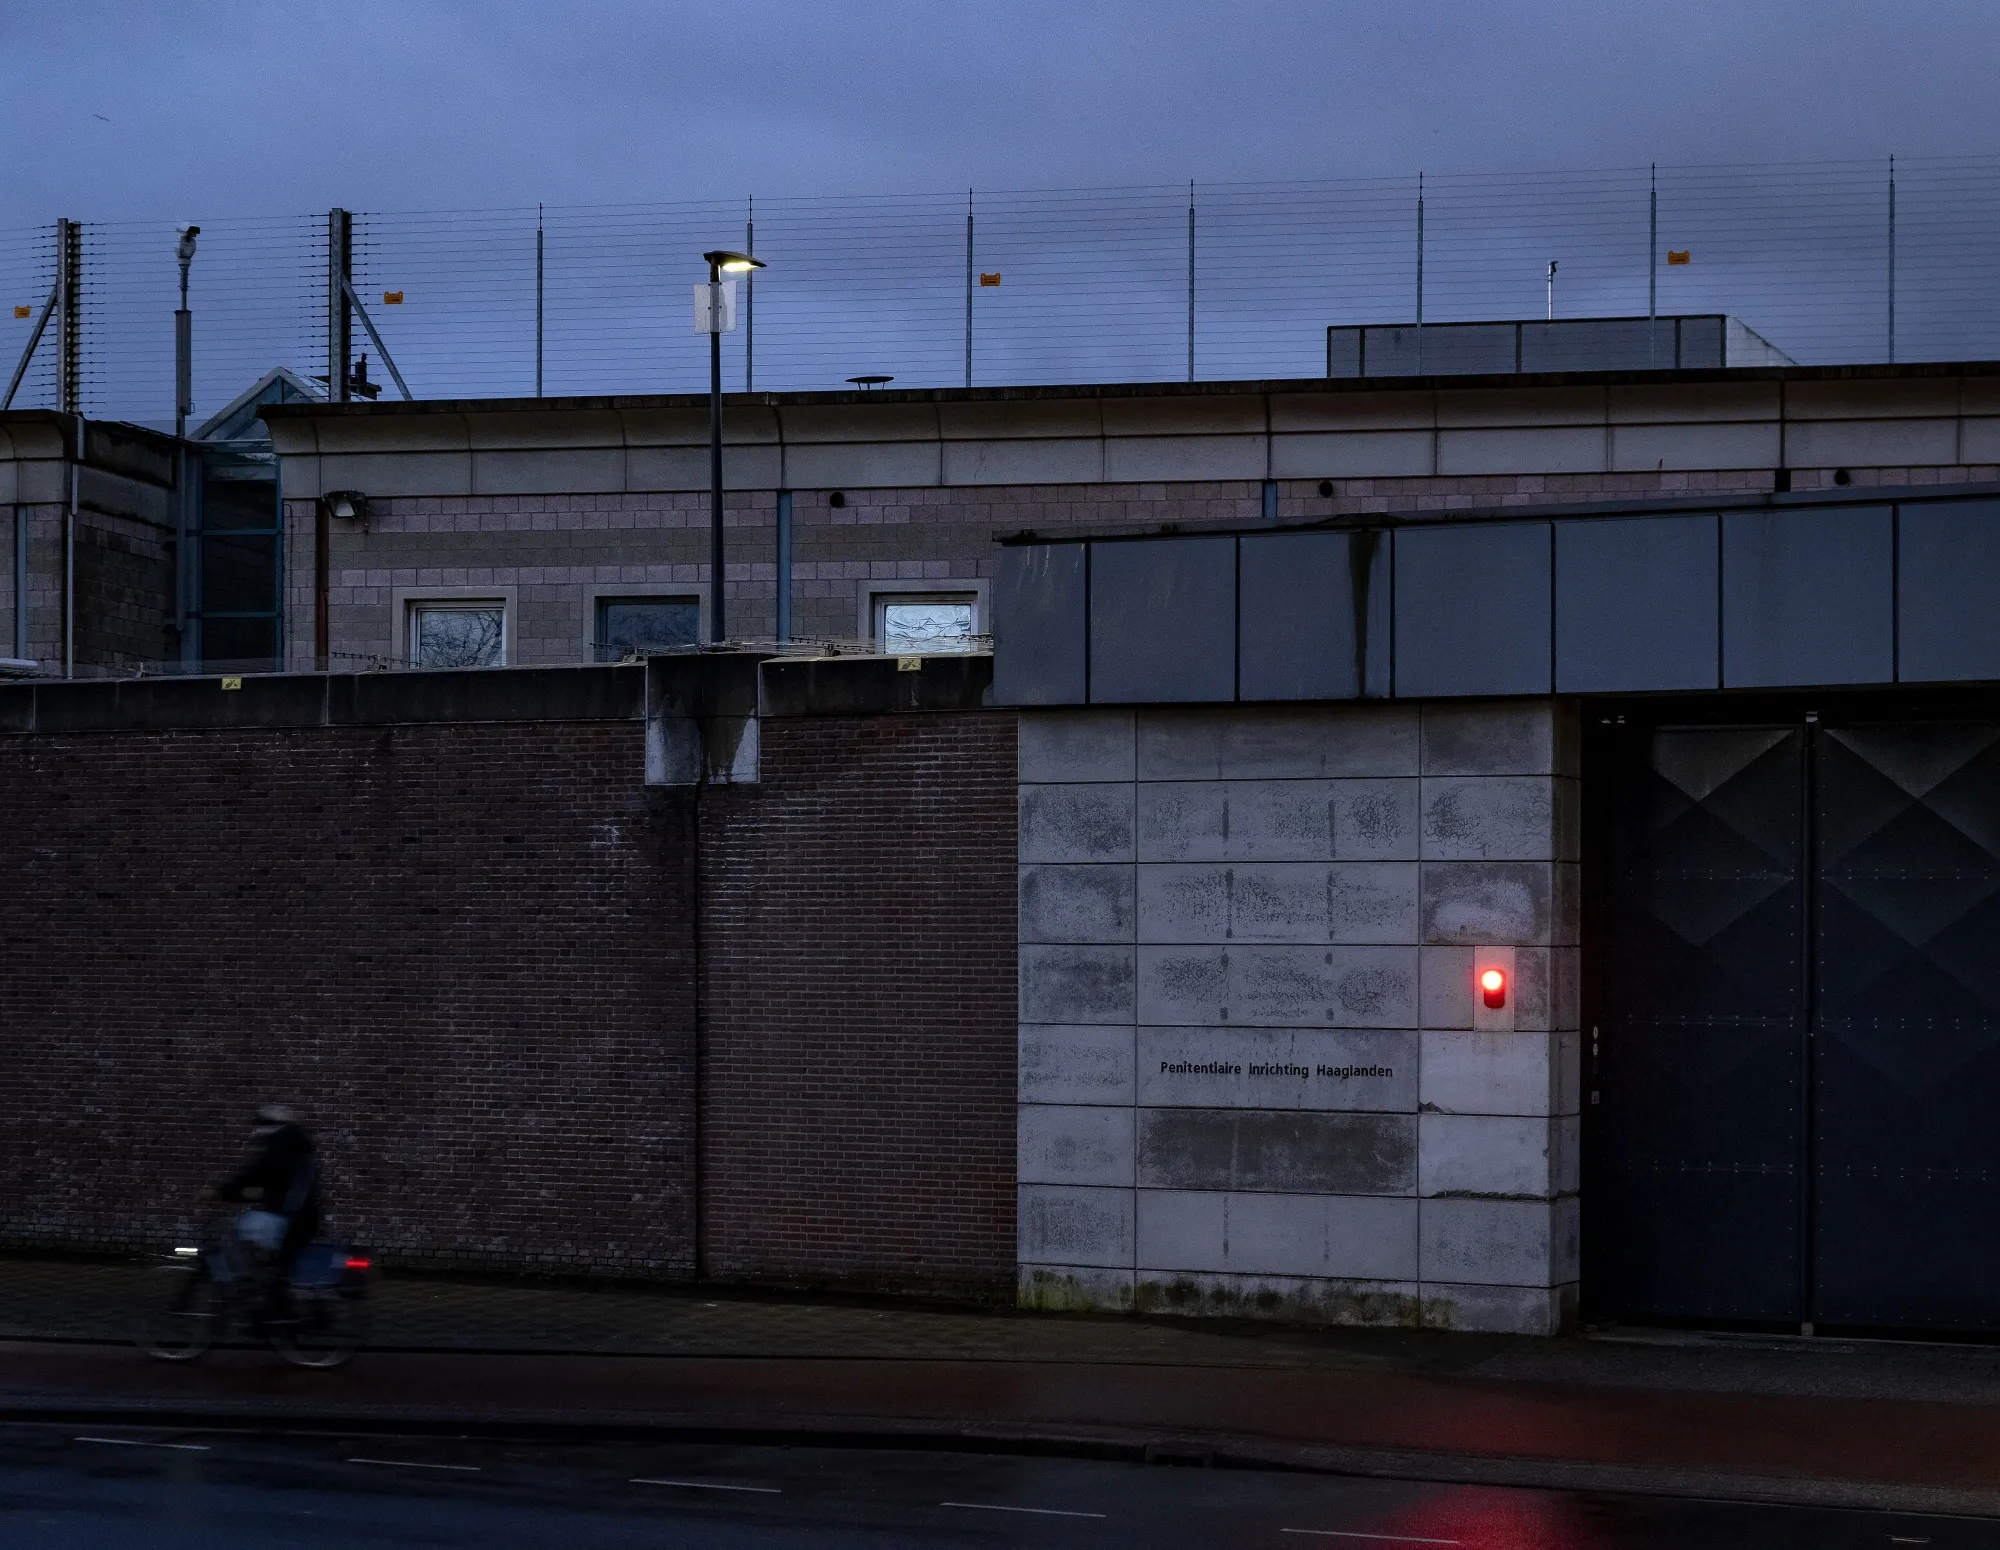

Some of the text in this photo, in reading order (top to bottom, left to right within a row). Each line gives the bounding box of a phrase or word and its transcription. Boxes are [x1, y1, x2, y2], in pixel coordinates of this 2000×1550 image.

[1160, 1061, 1393, 1079] Penitentiaire Inrichting Haaglanden
